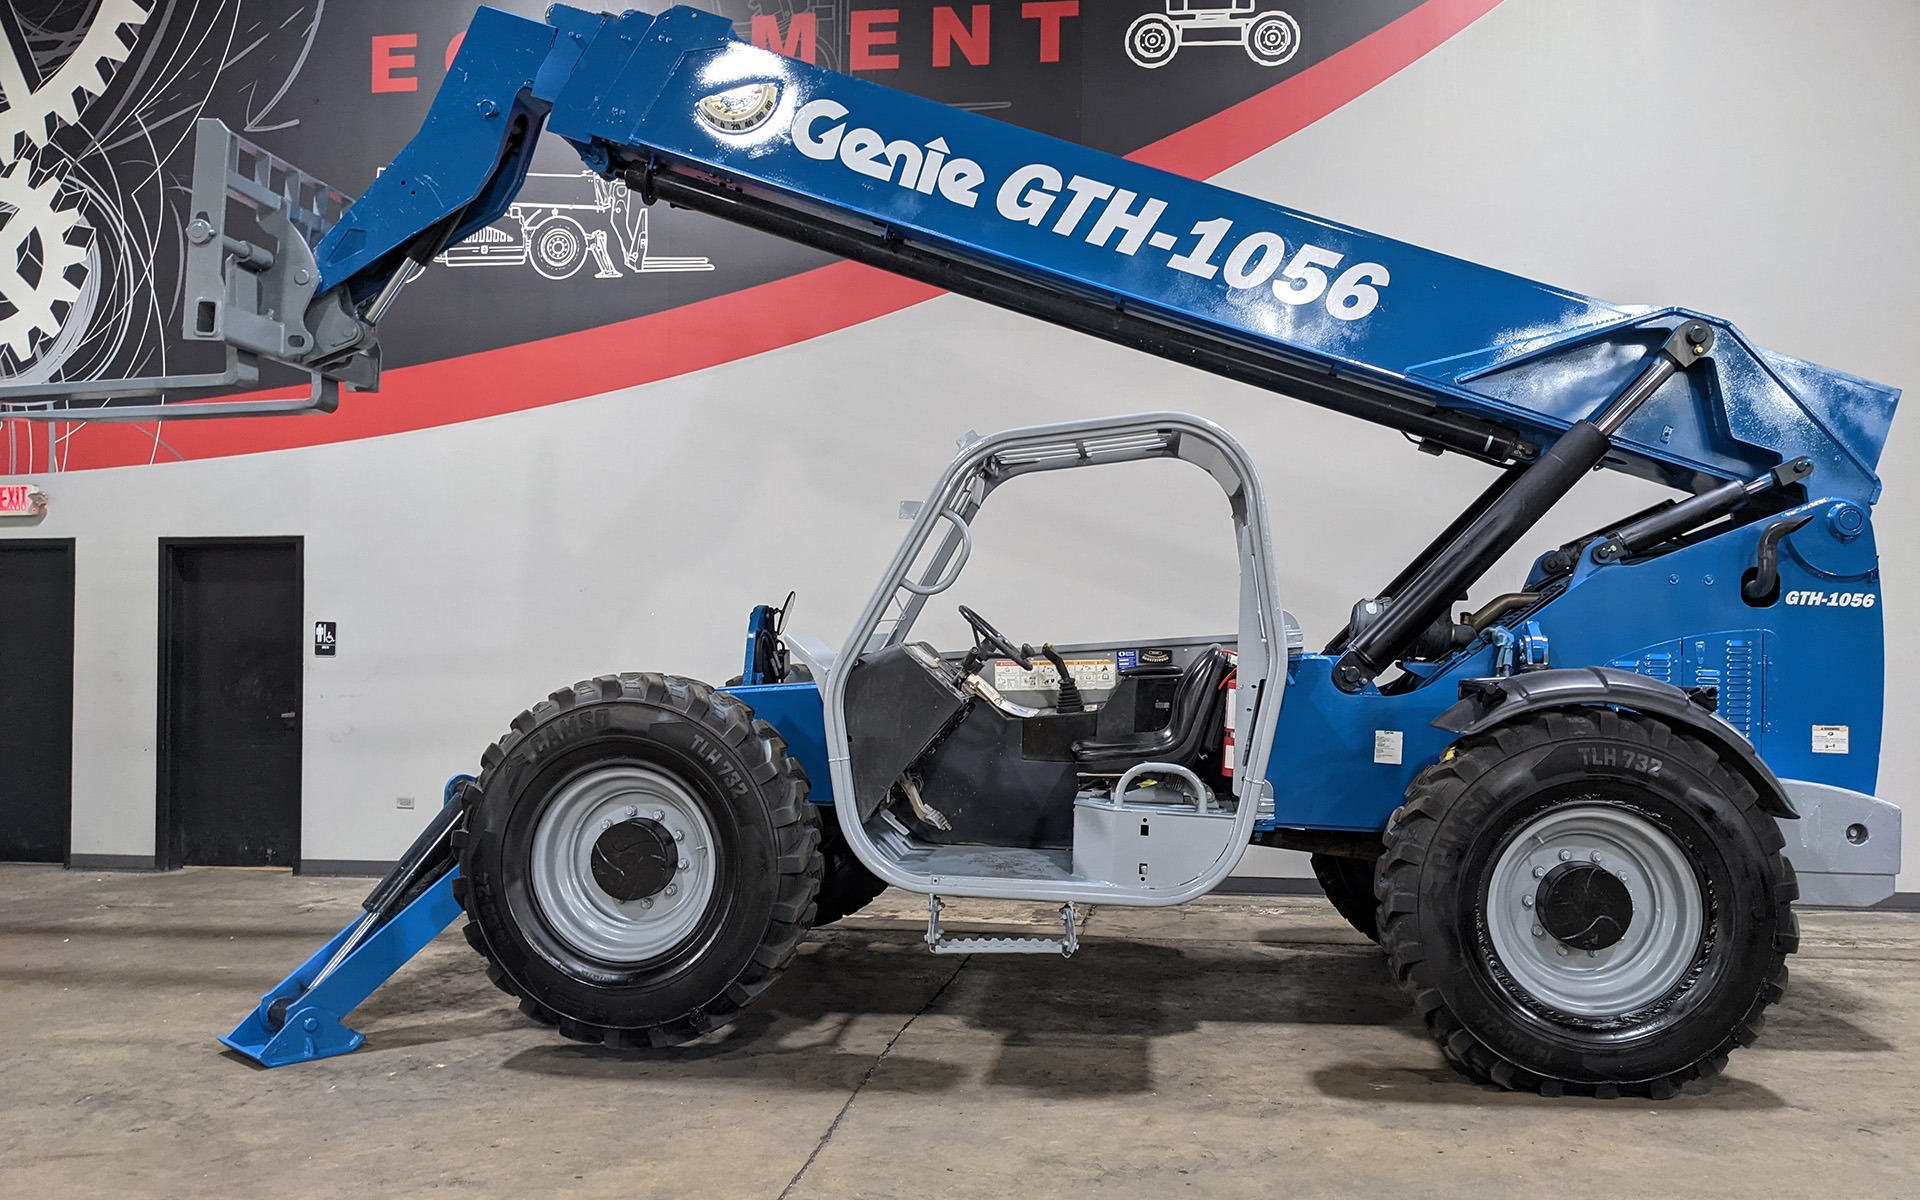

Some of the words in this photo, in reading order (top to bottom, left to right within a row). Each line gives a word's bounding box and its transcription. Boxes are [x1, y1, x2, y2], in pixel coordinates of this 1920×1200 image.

[371, 1, 1080, 94] EMENT
[996, 163, 1391, 321] GTH-1056
[0, 486, 28, 511] EXIT
[1785, 590, 1876, 608] GTH-1056
[689, 733, 724, 766] TLH
[716, 758, 749, 797] 732
[1578, 746, 1617, 767] TLH
[1622, 749, 1663, 778] 732
